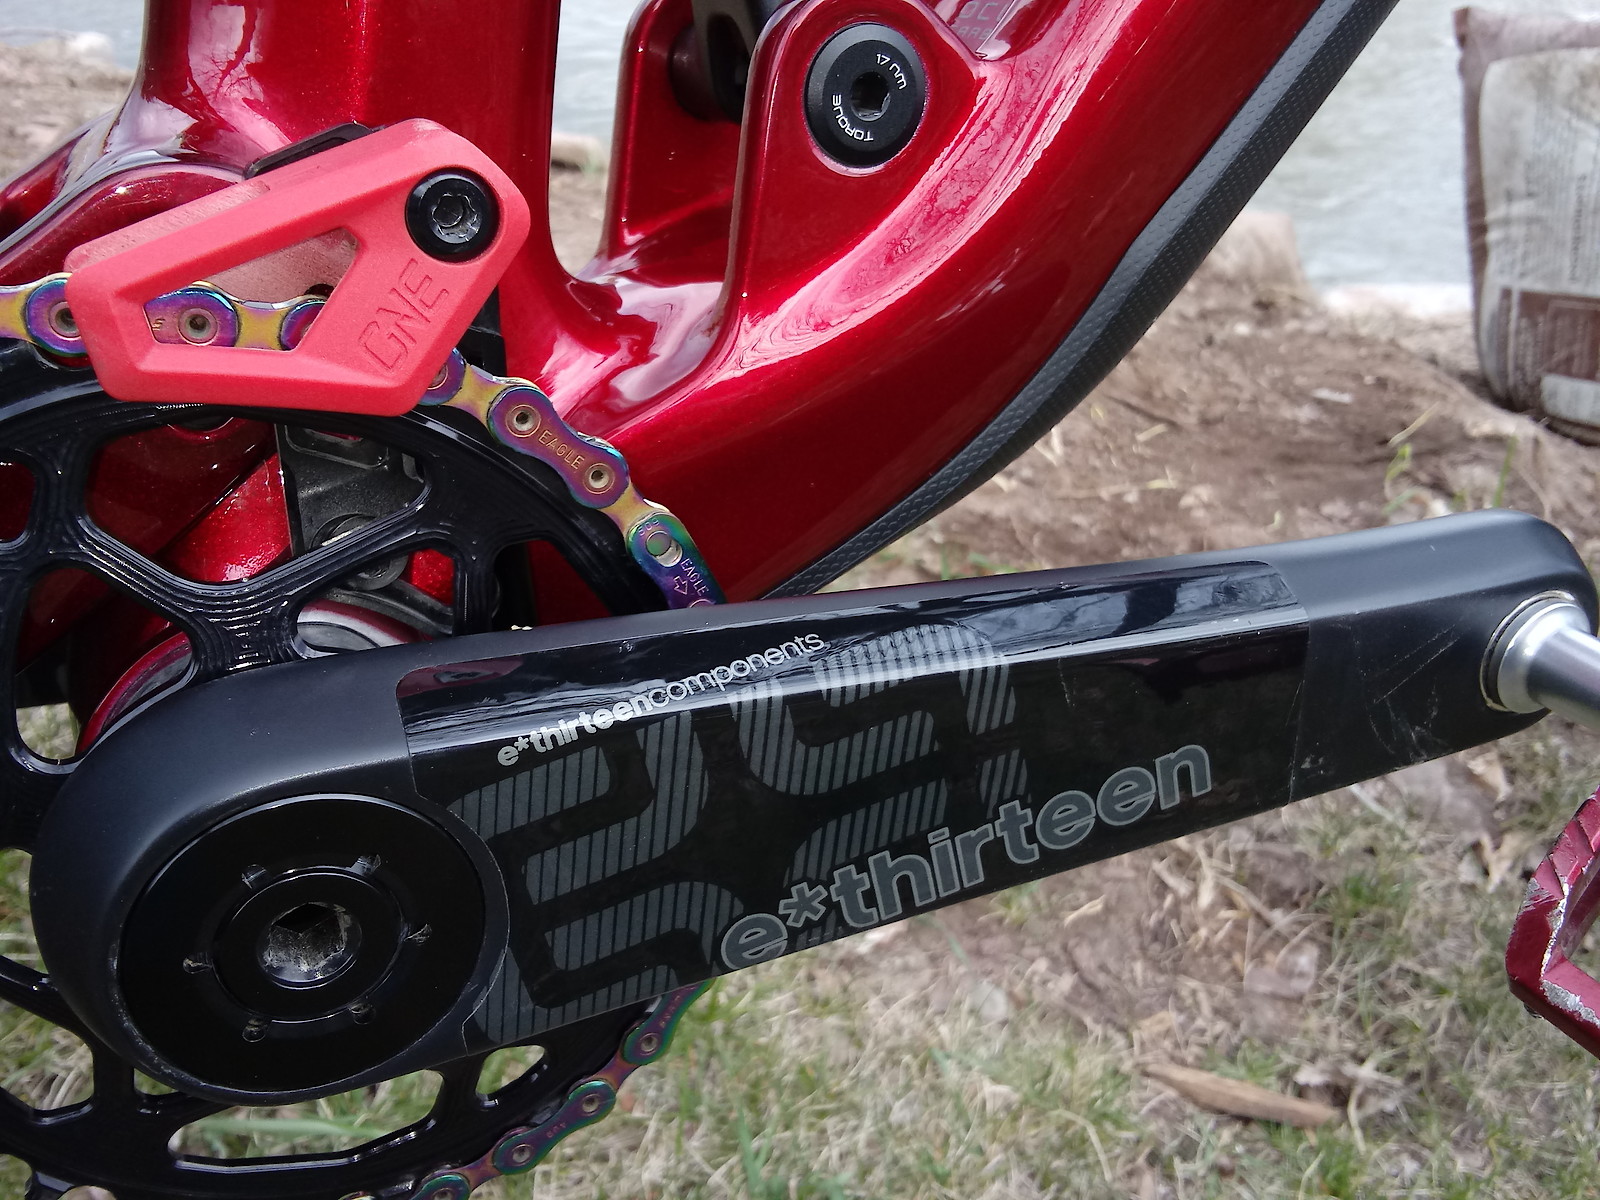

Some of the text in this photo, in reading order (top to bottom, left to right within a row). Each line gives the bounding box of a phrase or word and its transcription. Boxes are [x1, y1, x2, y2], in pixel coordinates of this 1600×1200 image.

[876, 53, 890, 66] 17
[832, 94, 874, 141] TORQUE
[538, 430, 585, 470] EAGLE
[681, 558, 710, 597] EAGLE
